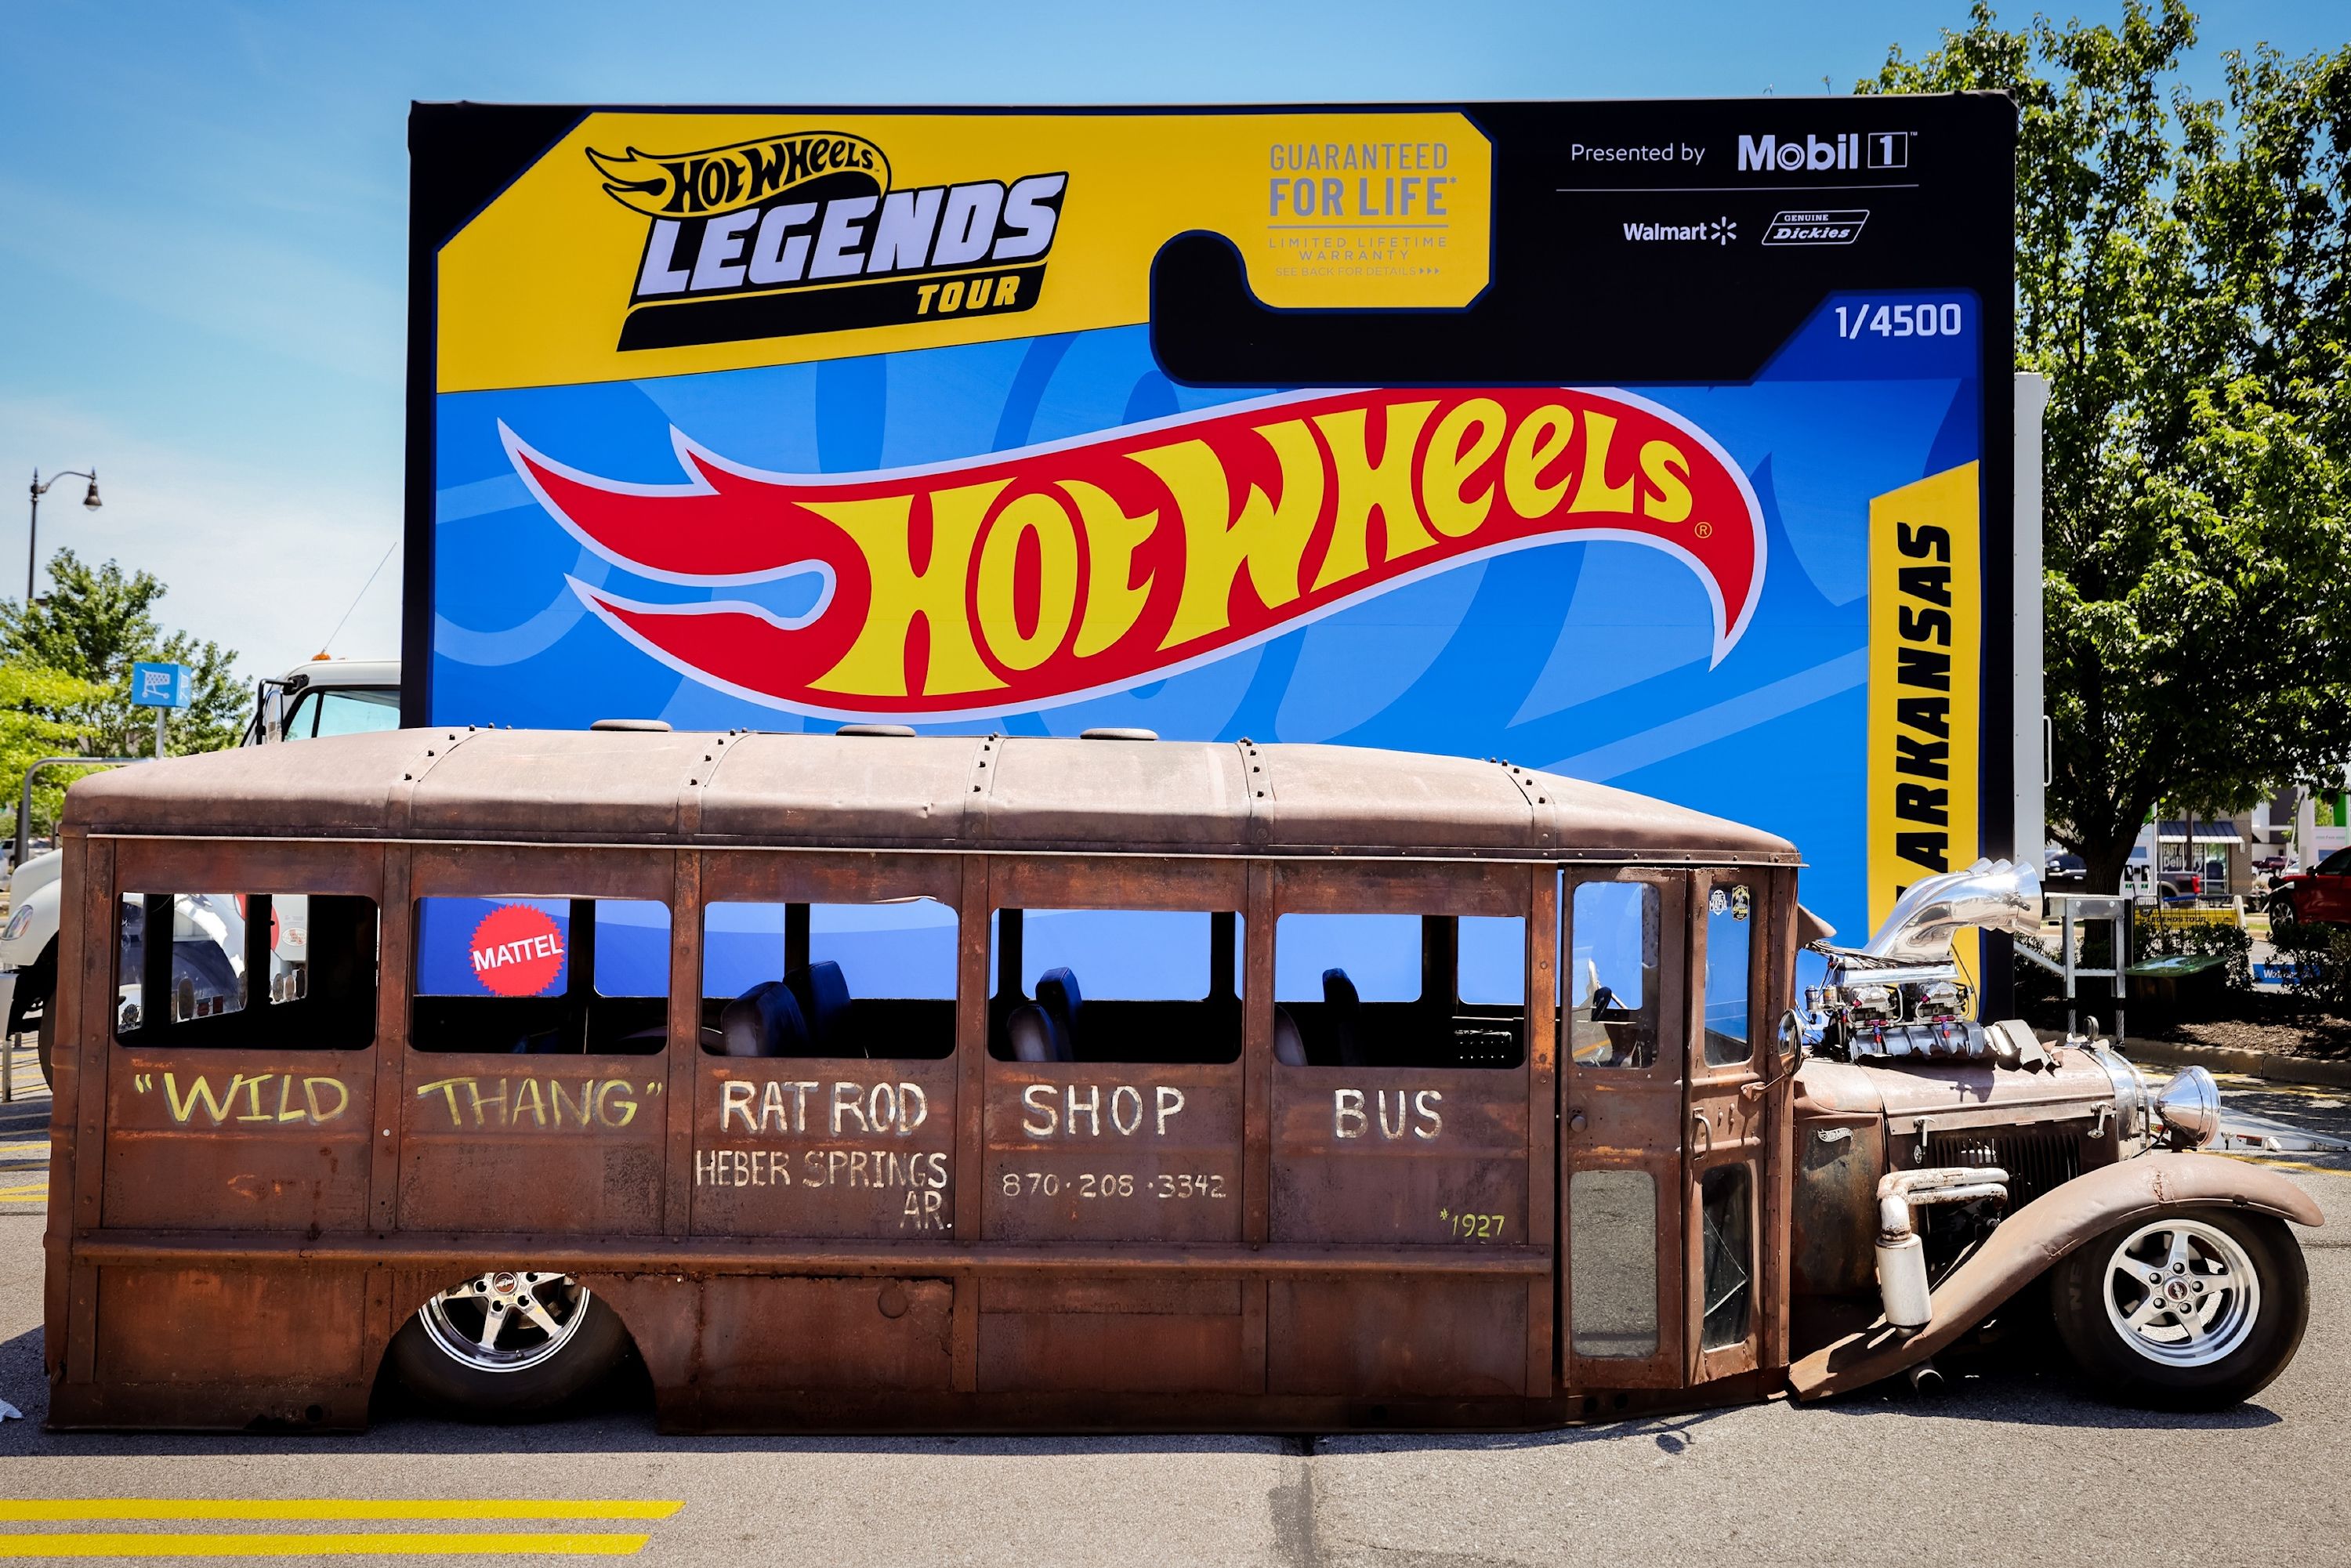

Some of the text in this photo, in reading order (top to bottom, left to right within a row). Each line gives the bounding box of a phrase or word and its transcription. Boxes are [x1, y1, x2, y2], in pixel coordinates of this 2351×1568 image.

[1270, 143, 1448, 171] GUARANTEED
[1571, 143, 1705, 165] Presented by
[1738, 133, 1859, 171] Mobil
[1879, 136, 1893, 165] 1
[1270, 177, 1345, 217] FOR
[637, 175, 1065, 295] LEGENDS
[1270, 237, 1447, 248] LIMITED LIFETIME
[1623, 222, 1707, 241] Walmart
[1773, 227, 1850, 239] Dickies
[1276, 267, 1415, 276] SEE BACK FOR DETAILS
[1299, 250, 1409, 261] WARRANTY
[918, 276, 1020, 314] TOUR
[1835, 303, 1962, 339] 1/4500
[1896, 522, 1951, 874] ARKANSAS
[2163, 843, 2178, 856] FAST
[2163, 856, 2204, 871] Deliry
[1709, 900, 1727, 911] MAFIA
[473, 933, 565, 972] MATTEL
[720, 1081, 1443, 1139] RAT ROD SHOP BUS
[696, 1150, 947, 1189] HEBER SPRINGS
[900, 1190, 952, 1231] AR.
